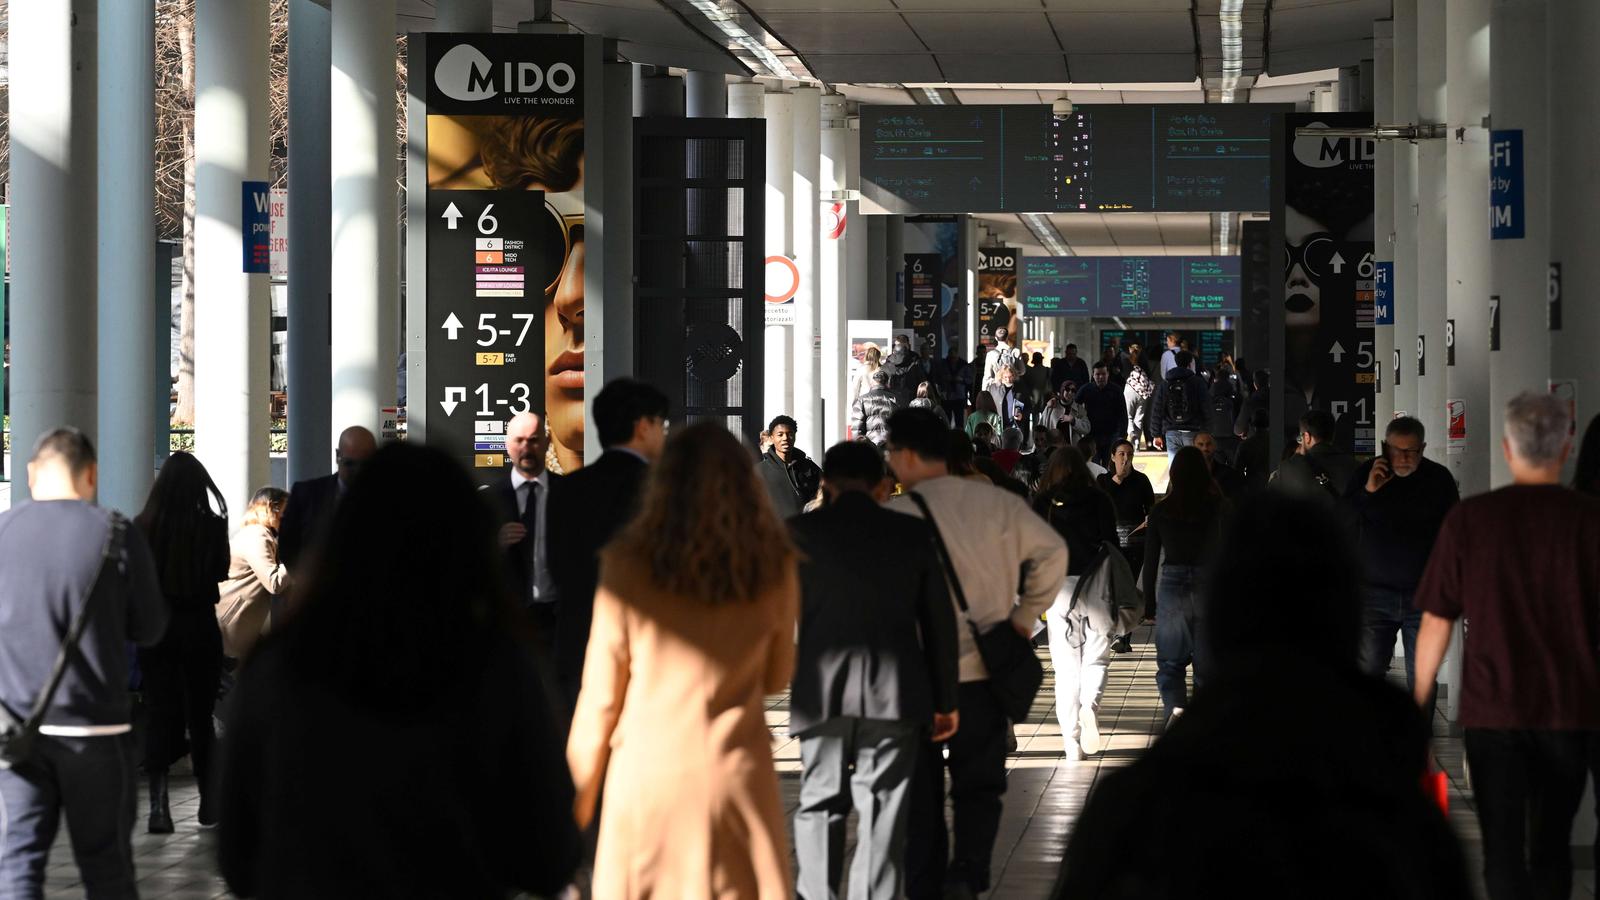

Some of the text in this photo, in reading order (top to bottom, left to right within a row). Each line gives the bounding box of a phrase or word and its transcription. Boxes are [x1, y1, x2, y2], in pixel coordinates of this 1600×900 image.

[468, 61, 576, 94] MIDO
[1320, 134, 1374, 161] MID
[477, 203, 498, 235] 6
[1491, 205, 1512, 228] IM
[487, 240, 493, 248] 6
[486, 254, 492, 262] 6
[913, 259, 922, 272] 6
[979, 256, 1014, 267] MIDO
[1357, 252, 1374, 278] 6
[913, 304, 937, 319] 5-7
[980, 302, 1000, 315] 5-7
[1490, 298, 1498, 328] 7
[476, 313, 534, 347] 5-7
[981, 324, 988, 335] 6
[1446, 322, 1453, 347] 8
[1417, 338, 1424, 359] 9
[483, 355, 499, 363] 5-7
[475, 383, 531, 416] 1-3
[487, 423, 492, 432] 1
[487, 456, 493, 465] 3
